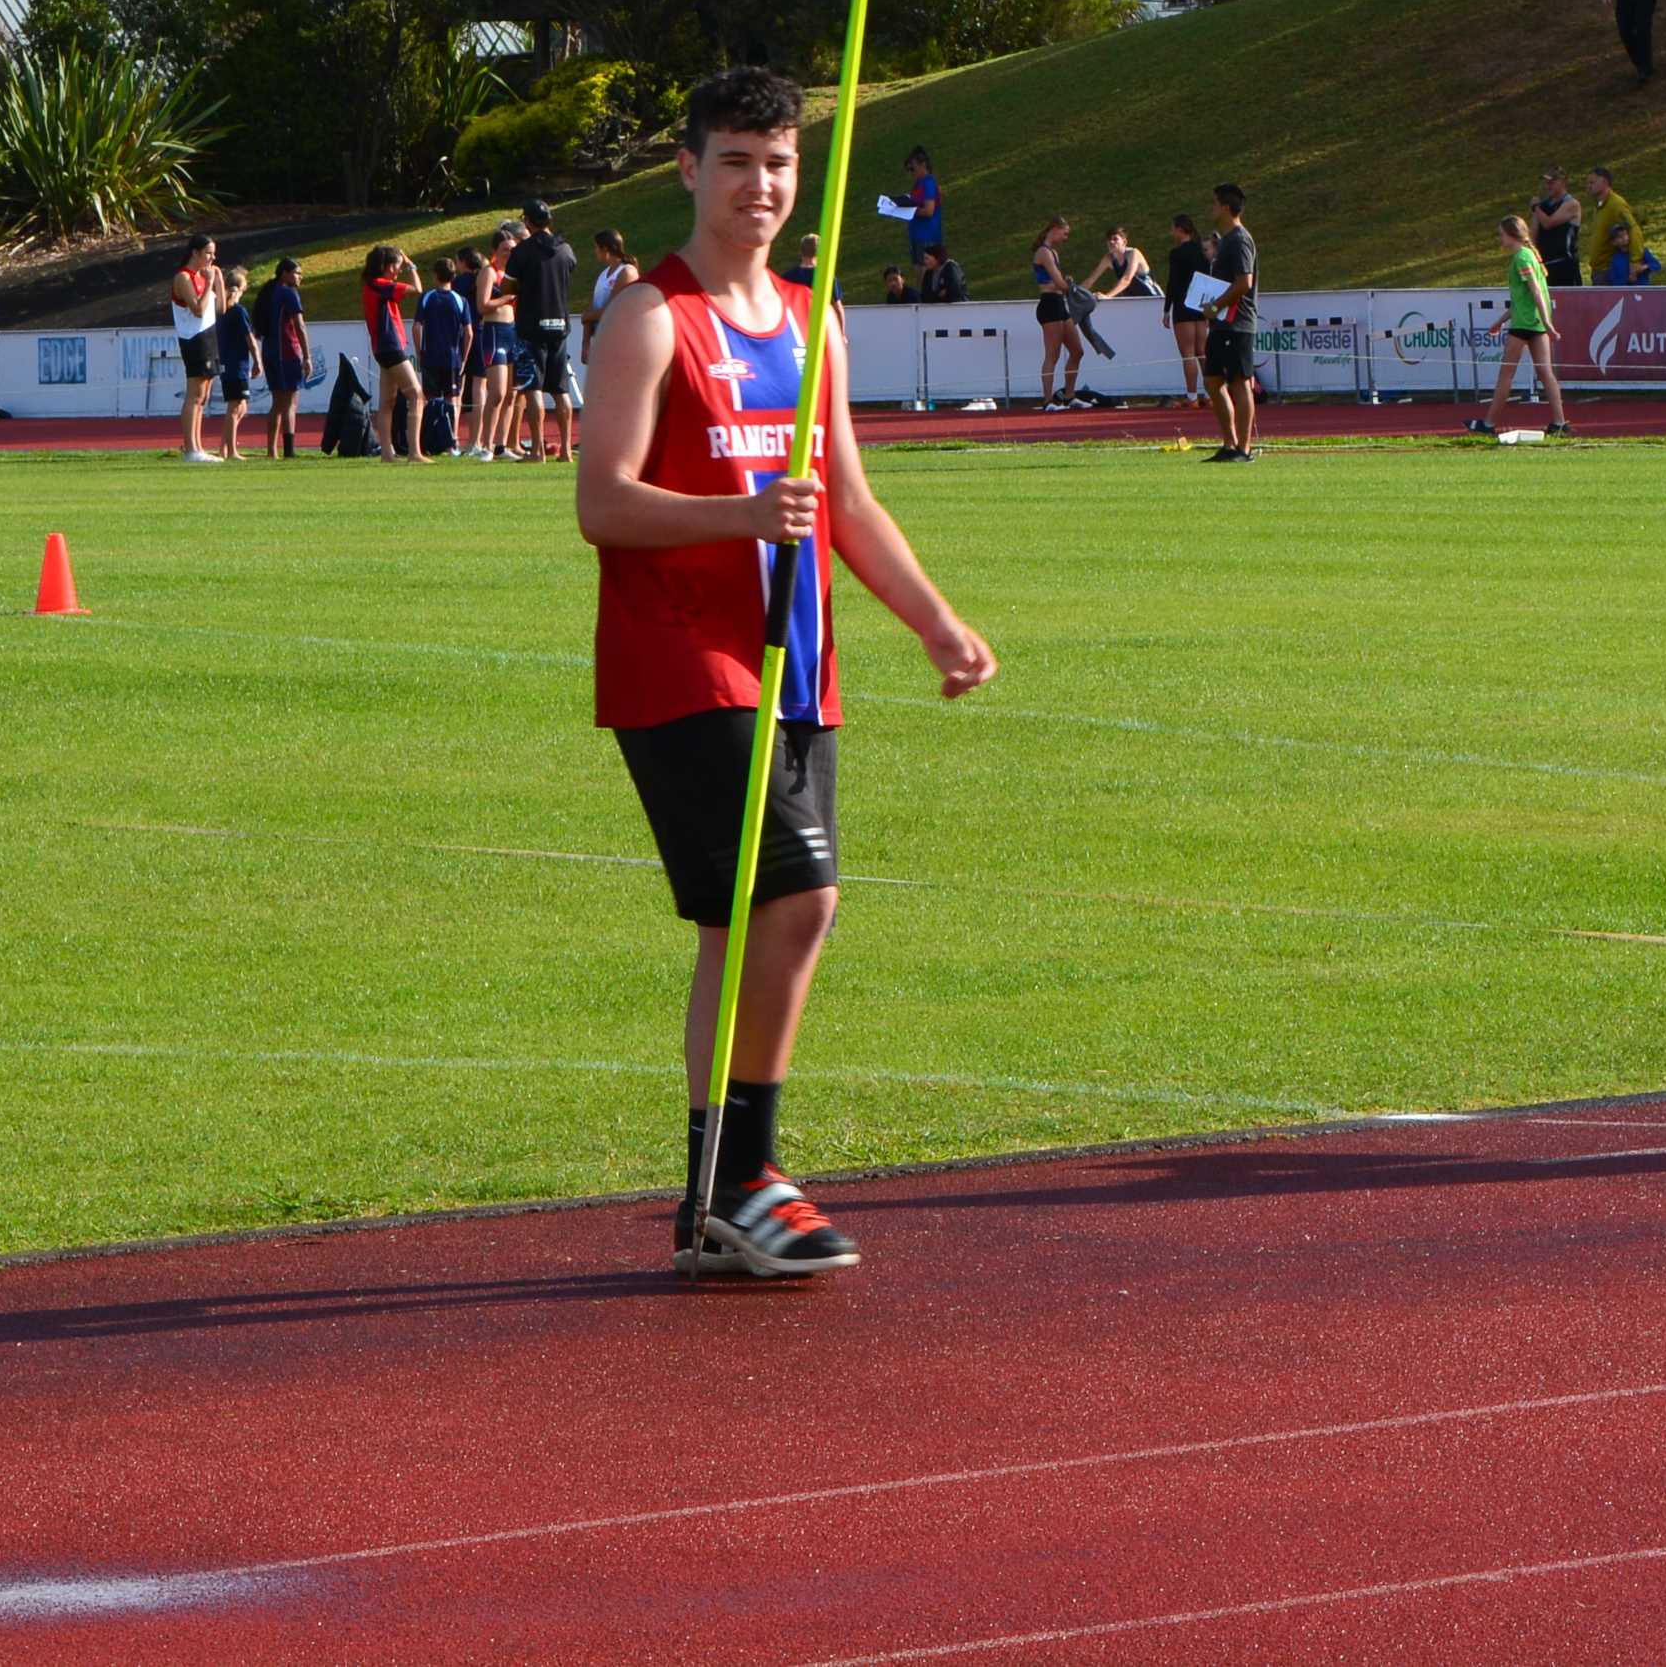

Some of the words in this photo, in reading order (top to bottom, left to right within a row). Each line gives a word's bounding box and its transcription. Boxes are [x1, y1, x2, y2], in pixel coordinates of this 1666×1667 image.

[1254, 331, 1297, 351] HOOSE
[1627, 333, 1666, 353] AUT
[39, 338, 86, 382] EDGE
